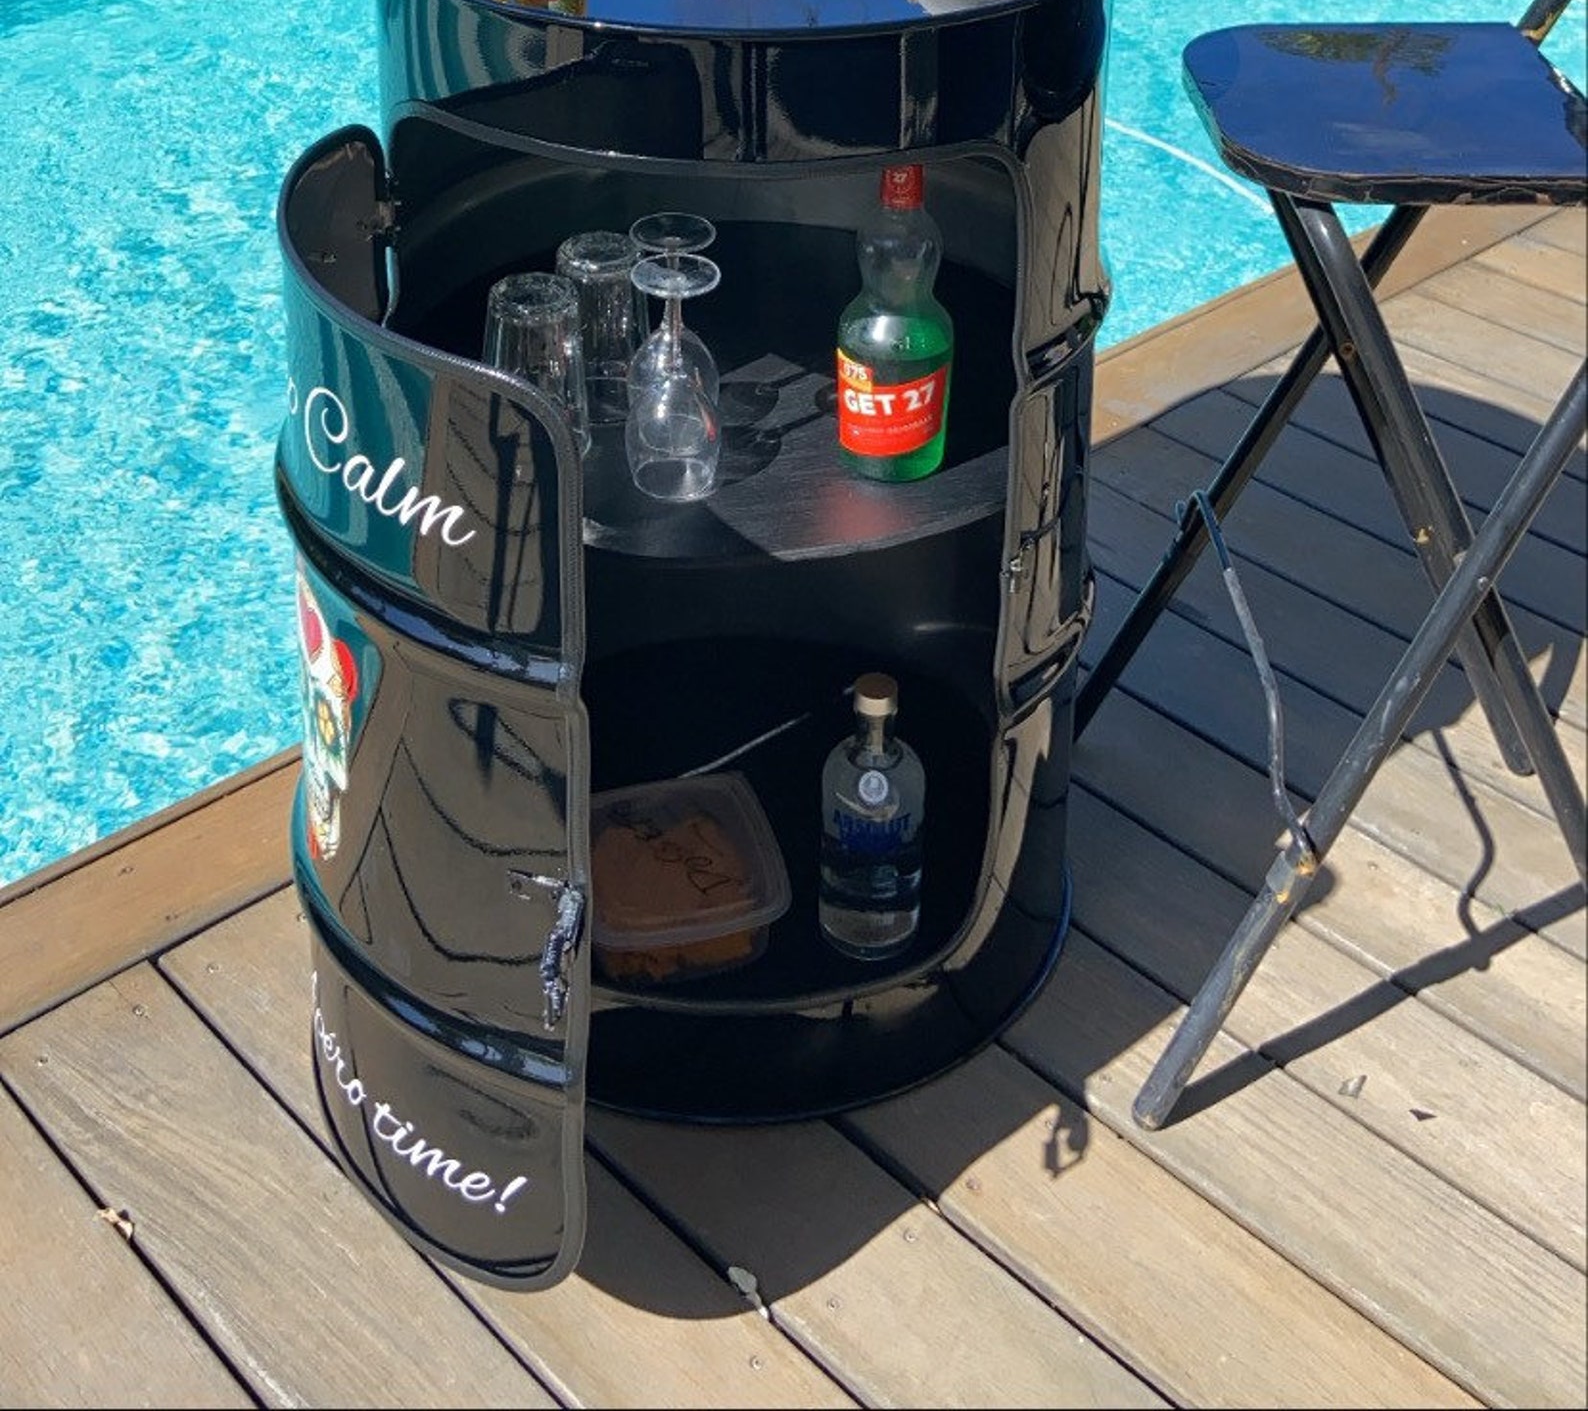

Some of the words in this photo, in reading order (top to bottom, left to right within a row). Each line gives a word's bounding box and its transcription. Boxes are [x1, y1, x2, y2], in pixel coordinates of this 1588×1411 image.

[843, 388, 896, 417] GET
[903, 379, 935, 412] 27
[305, 386, 476, 546] Calm
[373, 1101, 528, 1213] time!
